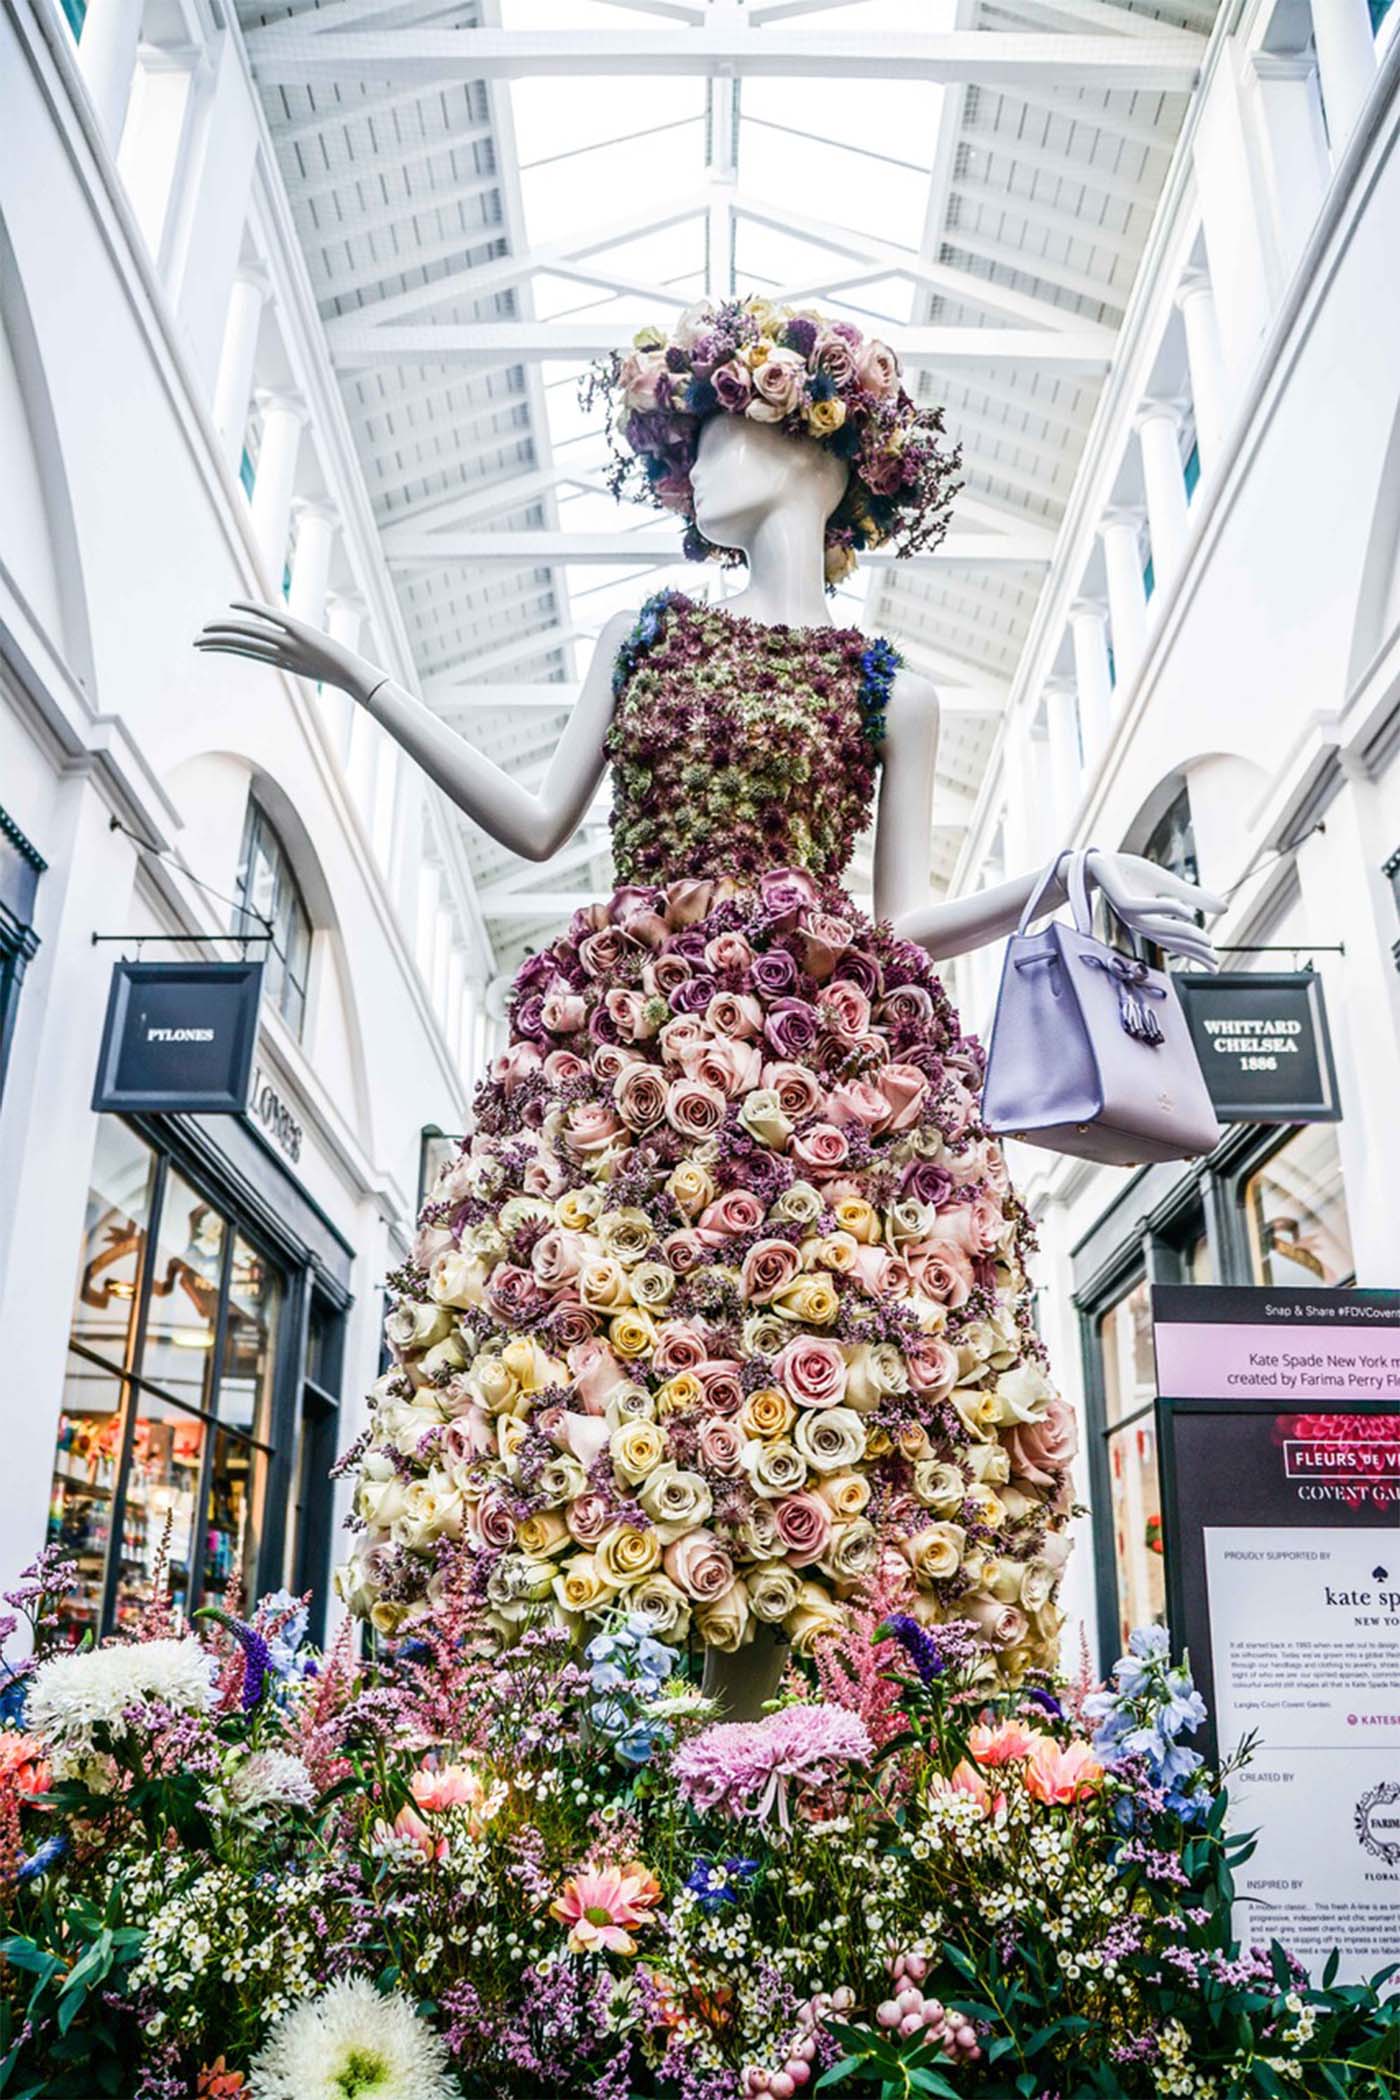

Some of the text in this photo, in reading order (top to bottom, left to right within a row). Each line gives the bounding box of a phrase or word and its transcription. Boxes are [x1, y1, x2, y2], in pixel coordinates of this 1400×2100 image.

[1204, 1020, 1301, 1035] WHITTARD
[147, 1028, 214, 1041] PYLONES
[1214, 1038, 1298, 1052] CHELSEA
[1241, 1057, 1277, 1070] 1886
[1265, 1304, 1292, 1317] Snap
[1294, 1305, 1303, 1316] &
[1306, 1305, 1335, 1317] Share
[1249, 1353, 1279, 1367] Kate
[1283, 1354, 1323, 1369] Spade
[1327, 1356, 1355, 1367] New
[1360, 1356, 1388, 1368] York
[1227, 1372, 1277, 1385] created
[1281, 1373, 1297, 1388] by
[1300, 1374, 1344, 1386] Farima
[1348, 1376, 1383, 1390] Perry
[1295, 1452, 1356, 1466] FLEURS
[1363, 1455, 1379, 1465] DE
[1298, 1486, 1367, 1501] COVENT
[1224, 1552, 1331, 1561] PROUDLY SUPPORTED BY
[1325, 1587, 1400, 1612] kate sp
[1354, 1617, 1379, 1626] NEW
[1240, 1773, 1294, 1783] CREATED BY
[1365, 1872, 1399, 1881] FLORAL
[1247, 1880, 1302, 1889] INSPIRED BY
